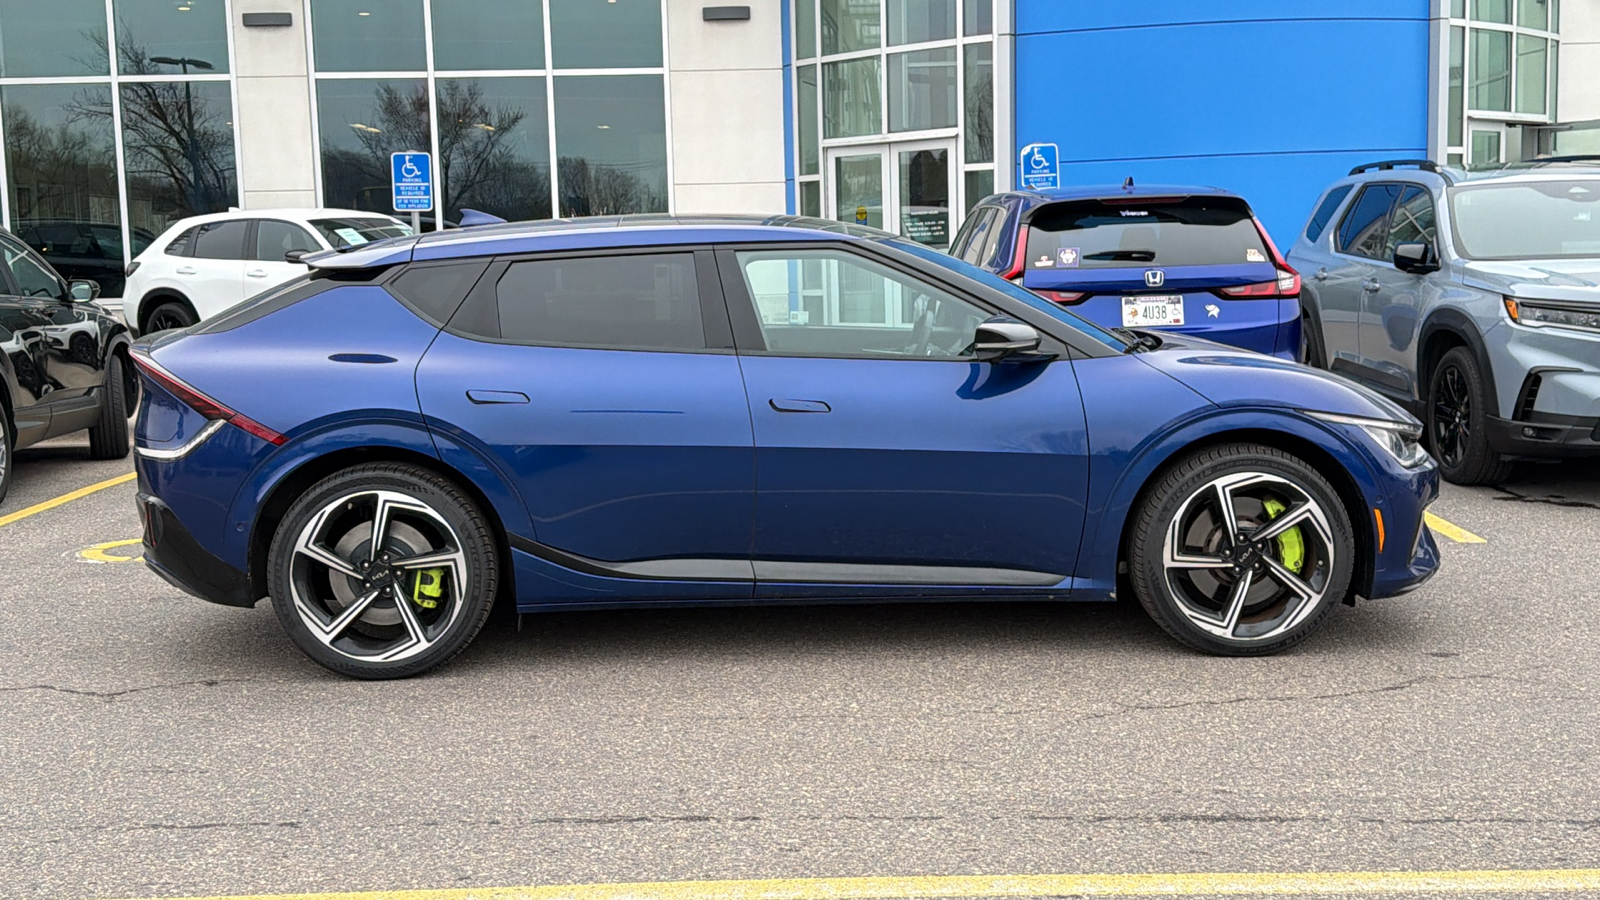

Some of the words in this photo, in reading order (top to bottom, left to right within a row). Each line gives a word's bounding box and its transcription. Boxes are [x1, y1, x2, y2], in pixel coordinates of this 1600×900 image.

[1142, 305, 1167, 319] 4U38
[1165, 466, 1212, 510] MICHELIN
[466, 535, 480, 596] MICHELIN
